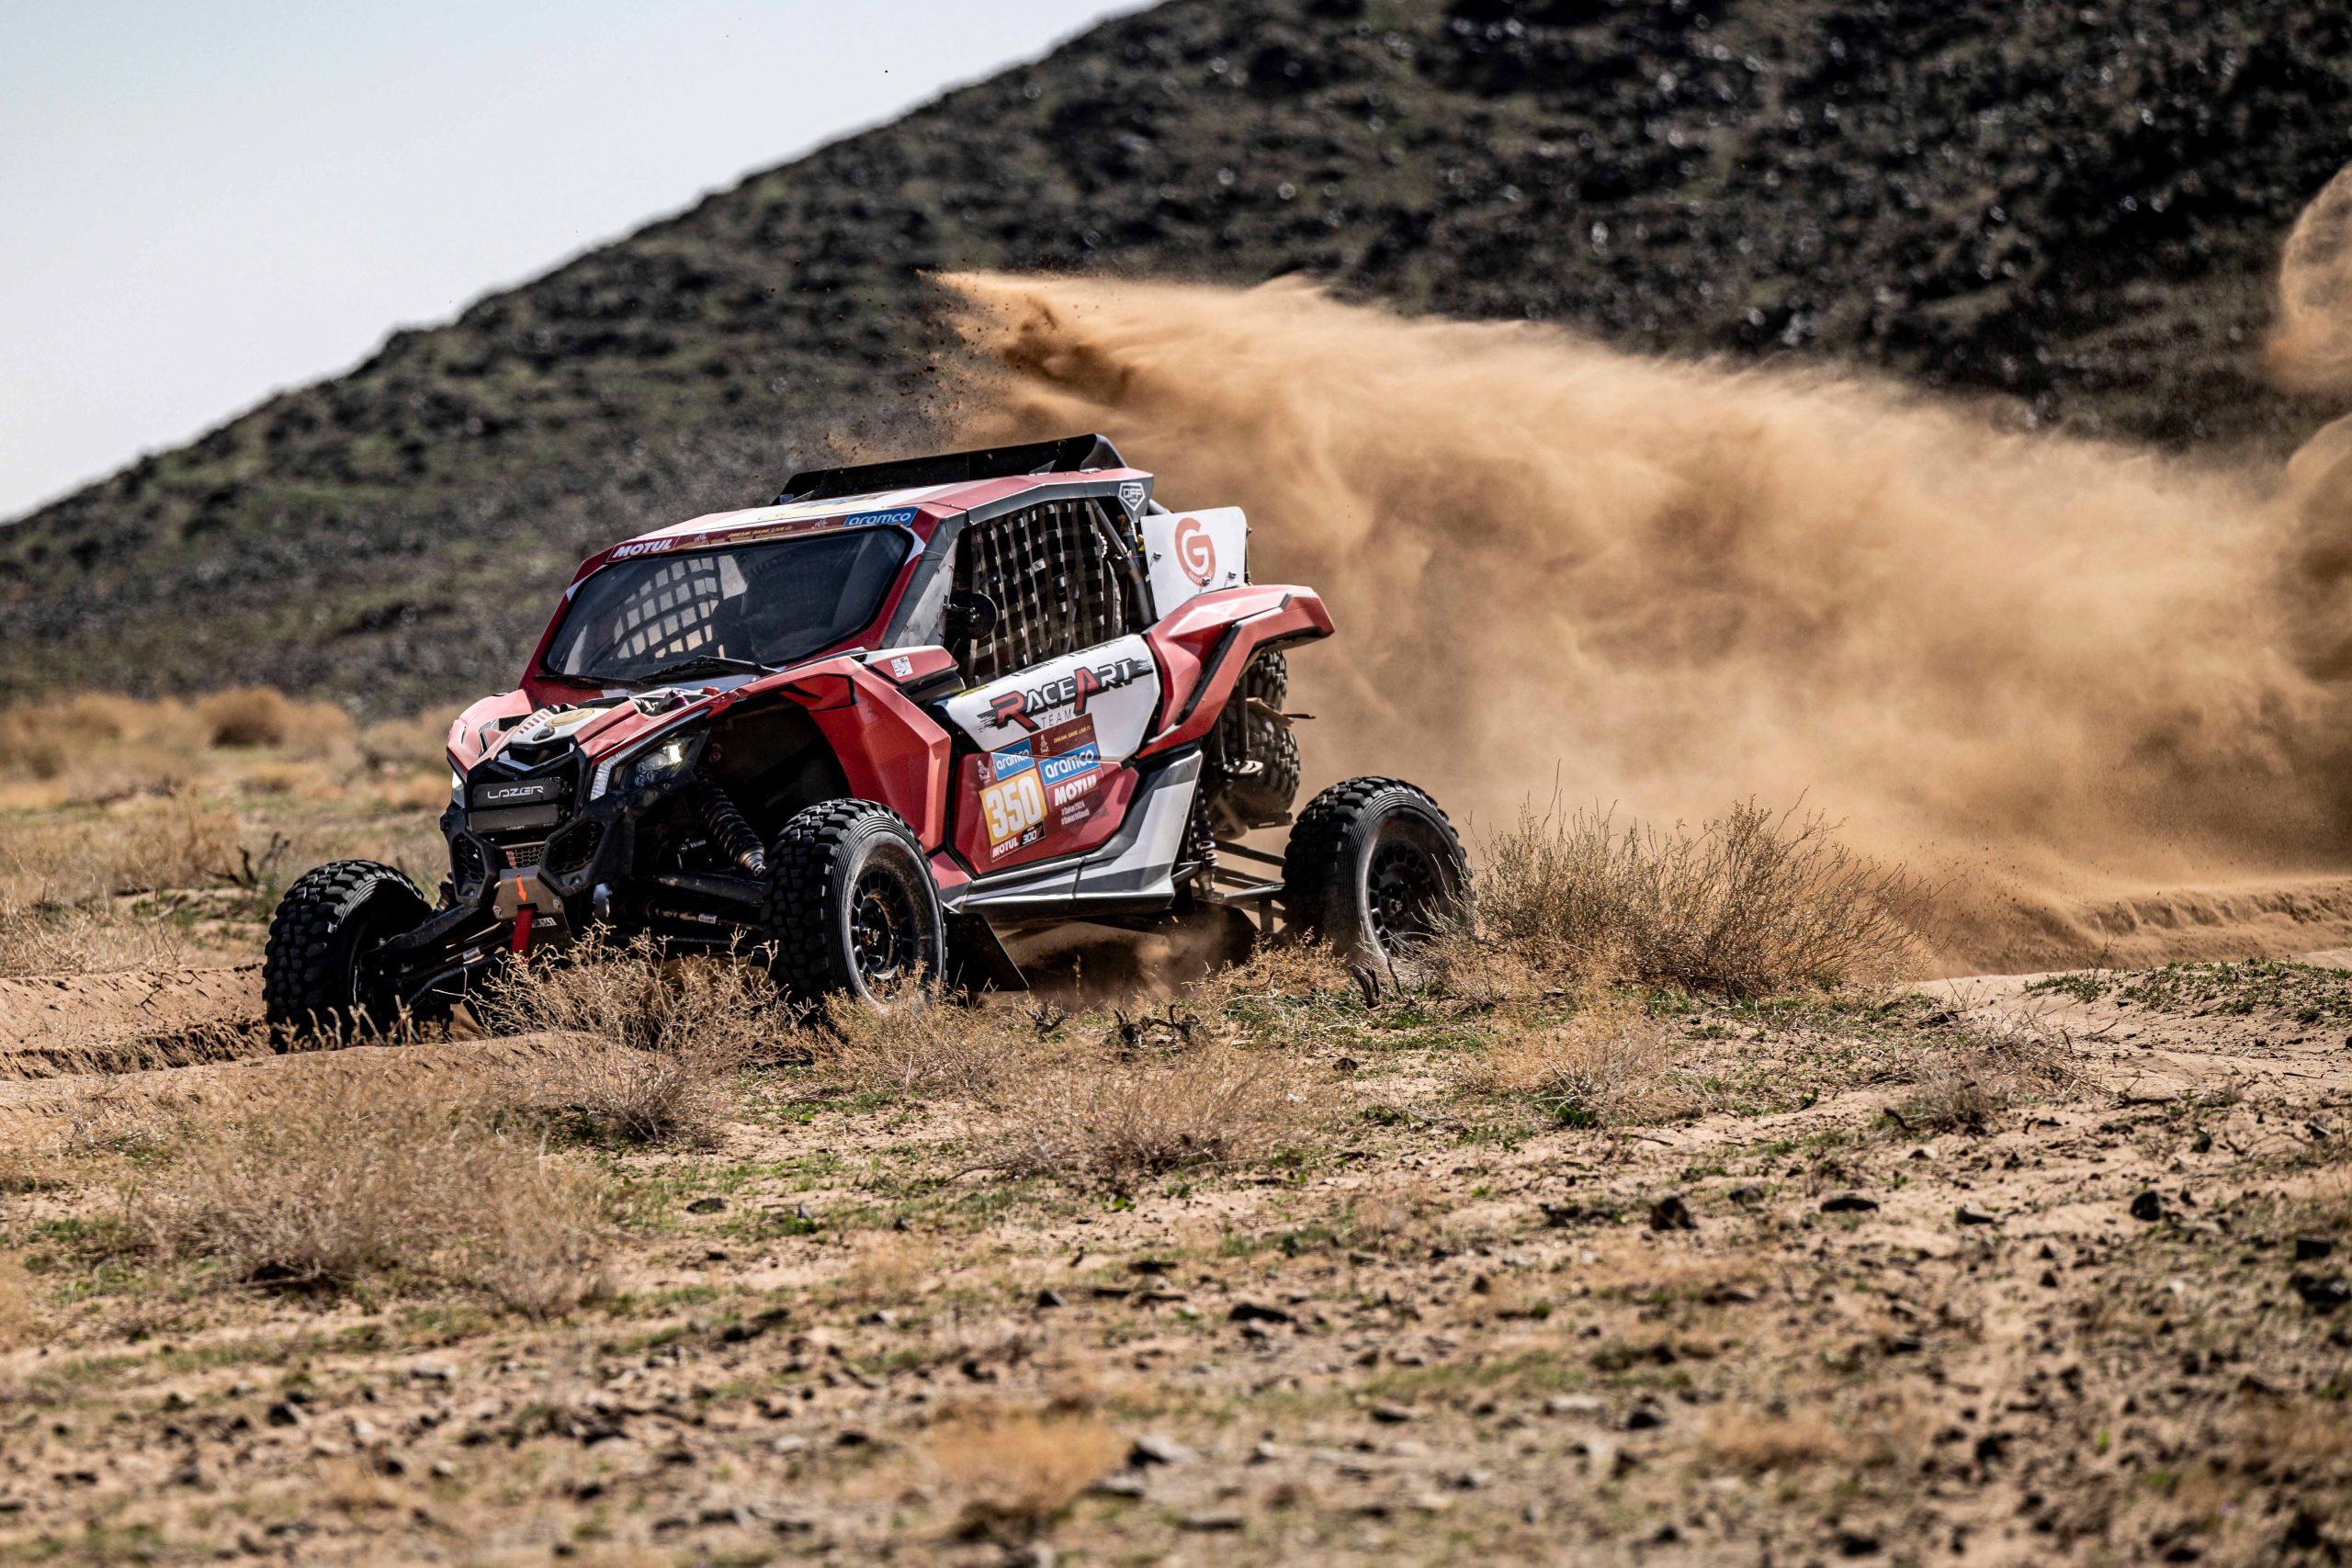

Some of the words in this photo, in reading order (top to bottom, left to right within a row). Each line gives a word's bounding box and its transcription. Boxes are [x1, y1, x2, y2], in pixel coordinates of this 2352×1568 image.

[1123, 488, 1142, 499] OFF
[848, 512, 911, 525] aramco
[612, 538, 673, 558] MOTUL
[1175, 517, 1216, 587] G
[1041, 710, 1072, 728] TEAM
[997, 750, 1029, 770] aramco
[1045, 750, 1094, 778] aramco
[487, 786, 544, 798] LAZER
[985, 775, 1042, 838] 350
[992, 837, 1019, 858] MOTUL
